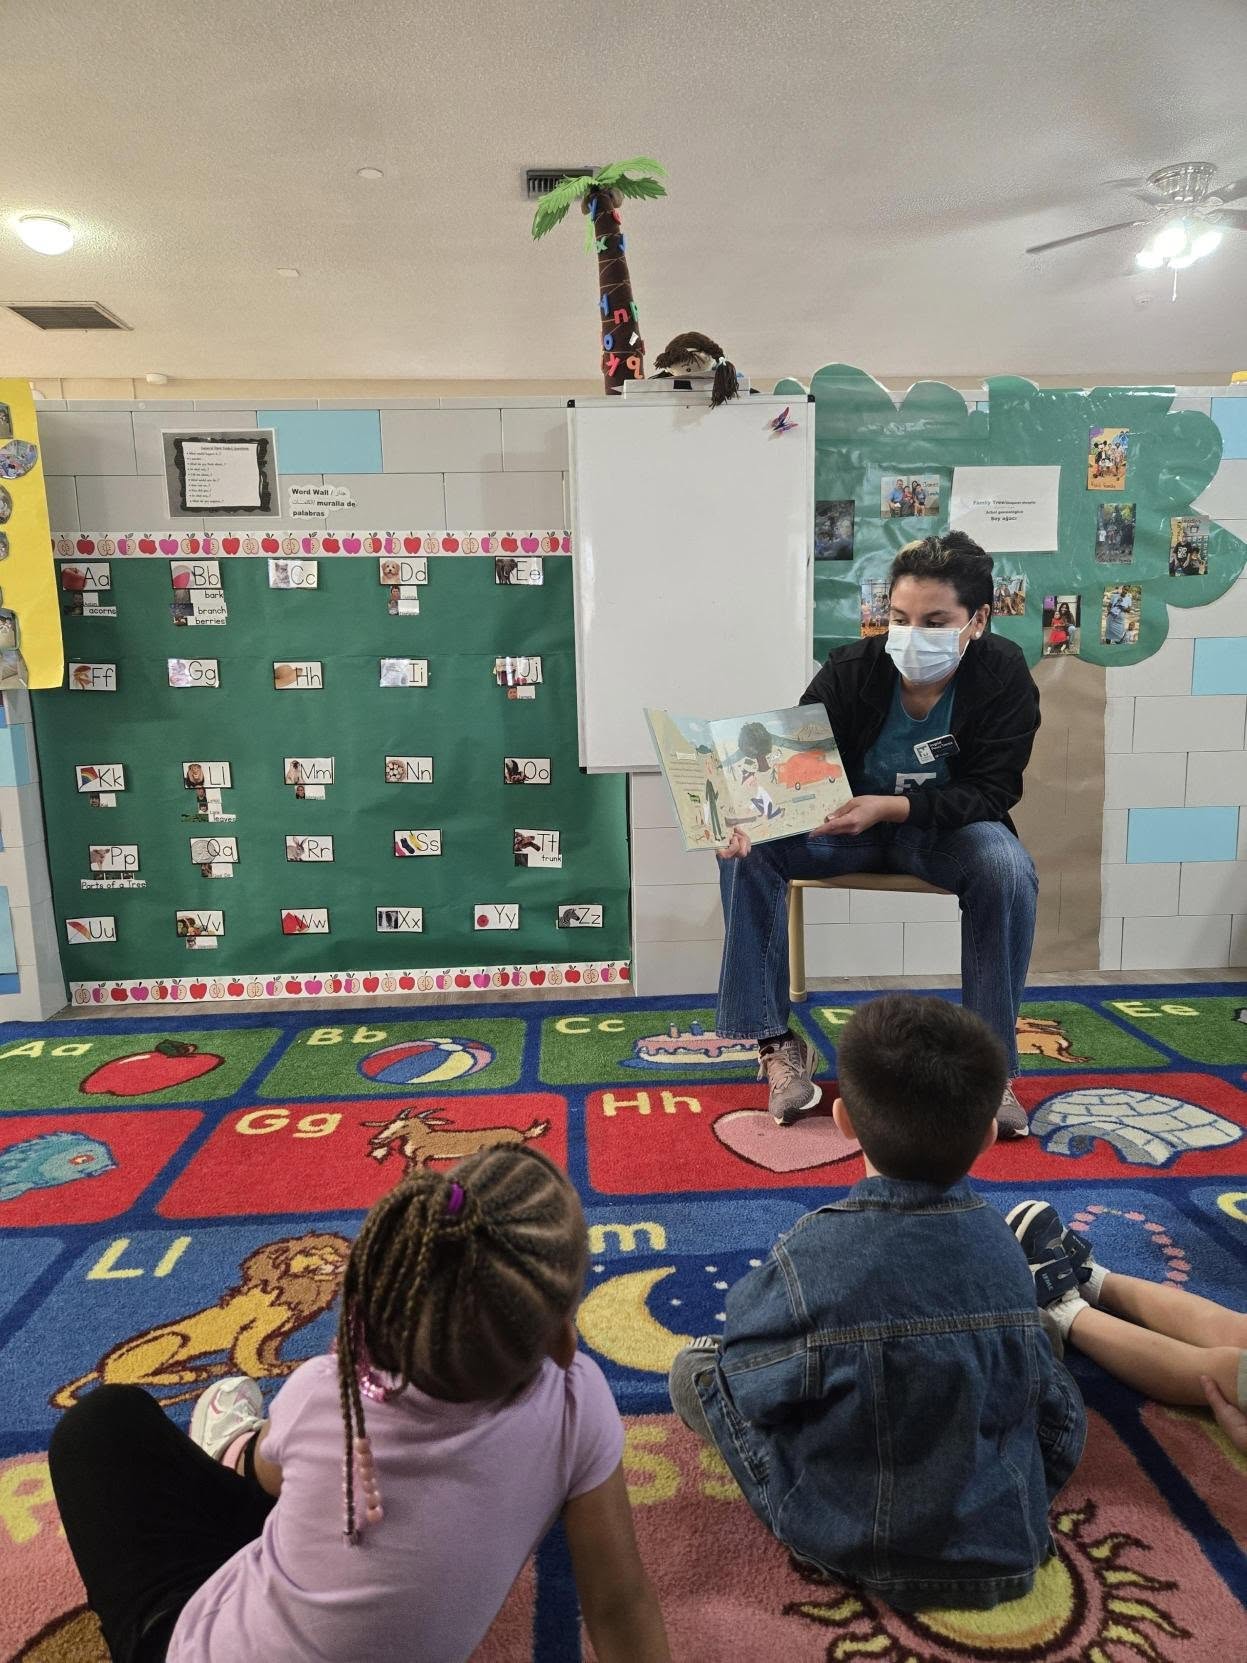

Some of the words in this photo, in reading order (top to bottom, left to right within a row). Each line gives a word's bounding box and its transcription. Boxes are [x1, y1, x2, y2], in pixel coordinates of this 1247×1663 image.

[84, 567, 110, 587] Aa
[193, 565, 220, 586] Bb
[291, 565, 316, 586] Cc
[400, 561, 427, 582] Dd
[204, 590, 224, 599] bark
[198, 606, 227, 615] branch
[195, 617, 226, 625] berries
[91, 667, 113, 687] Ff
[189, 661, 216, 685] Gg
[295, 667, 321, 686] Hh
[409, 663, 423, 683] Ii
[98, 768, 122, 787] Kk
[300, 763, 331, 780] Mm
[407, 762, 431, 781] Nn
[523, 761, 548, 780] Oo
[308, 840, 330, 859] Rr
[417, 833, 439, 851] Ss
[537, 833, 558, 853] Tt
[110, 847, 135, 870] Pp
[541, 854, 562, 863] trunk
[81, 881, 103, 890] Parts
[106, 880, 116, 888] of
[197, 914, 221, 932] Vv
[295, 914, 326, 929] Ww
[399, 911, 421, 929] Xx
[494, 905, 516, 929] Yy
[578, 908, 600, 925] Zz
[88, 921, 114, 939] Uu
[1112, 1001, 1200, 1018] Ee
[555, 1016, 627, 1035] Cc
[306, 1026, 388, 1047] Bb
[0, 1039, 95, 1059] Aa
[601, 1090, 702, 1116] Hh
[234, 1107, 343, 1138] Gg
[86, 1236, 192, 1281] Ll
